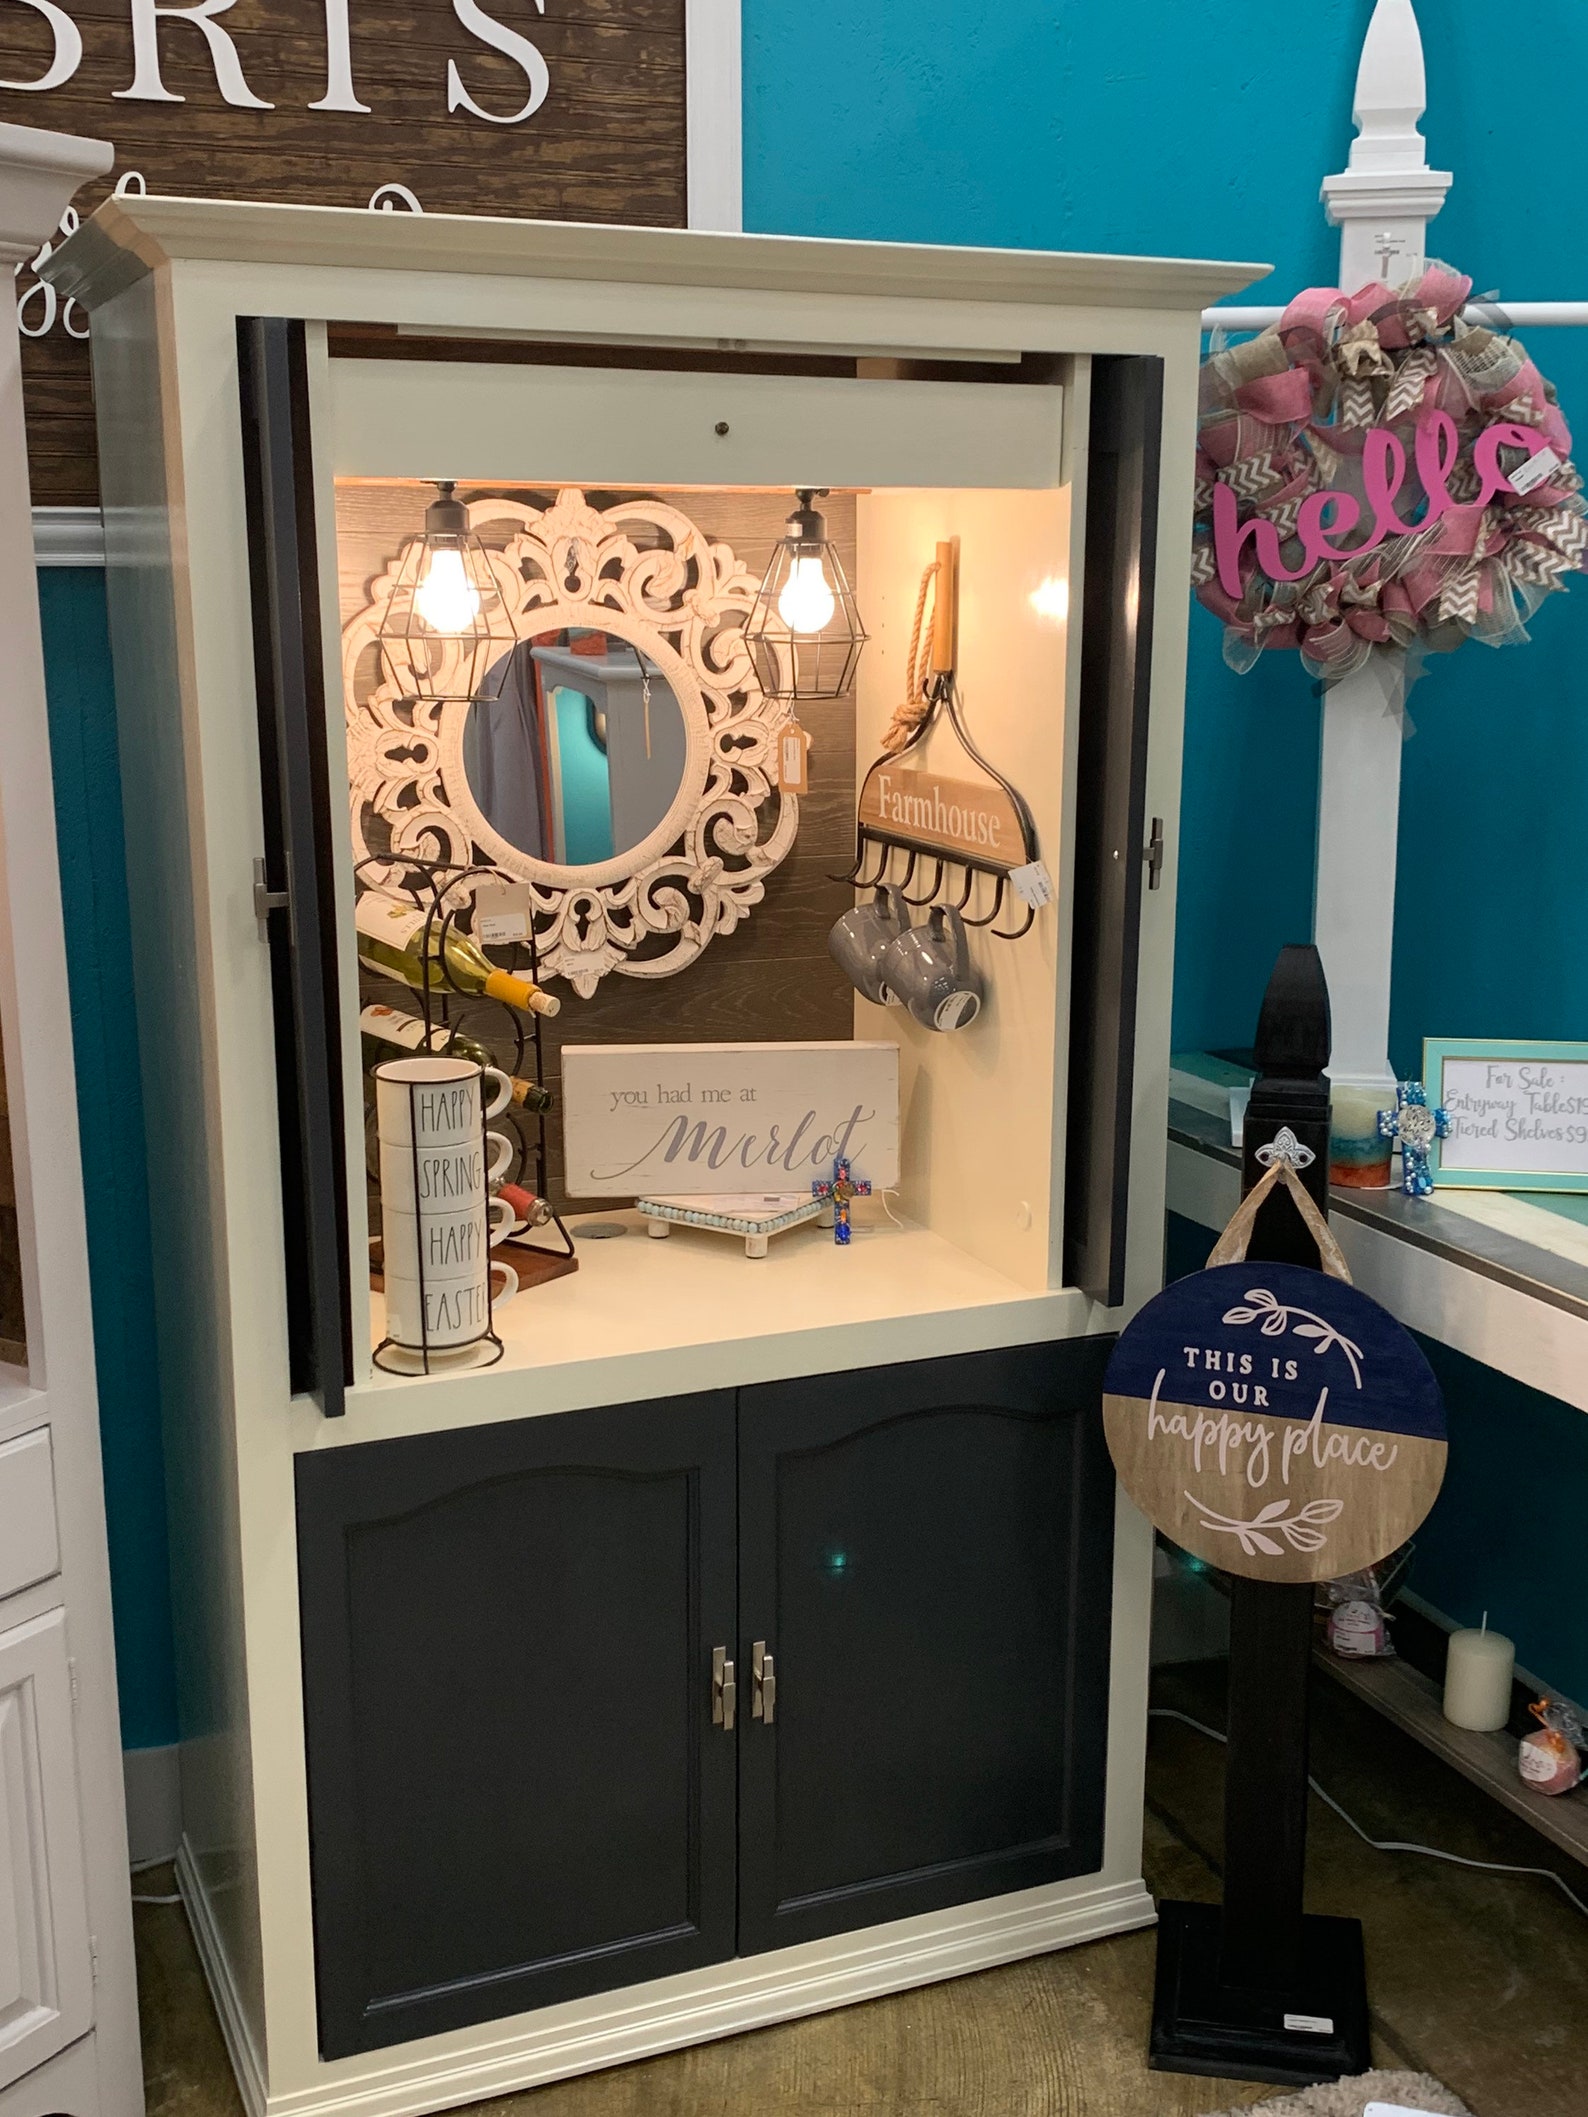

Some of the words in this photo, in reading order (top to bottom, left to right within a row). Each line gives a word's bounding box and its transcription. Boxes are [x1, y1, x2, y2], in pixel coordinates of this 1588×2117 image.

[1213, 409, 1552, 600] hello
[878, 774, 1001, 848] Farmhouse
[610, 1090, 648, 1111] you
[657, 1083, 692, 1104] had
[701, 1090, 731, 1103] me
[740, 1087, 757, 1102] at
[1486, 1065, 1512, 1089] For
[421, 1086, 474, 1132] HAPPY
[1444, 1088, 1516, 1118] Entryway
[590, 1104, 876, 1180] Merlot
[1450, 1115, 1498, 1139] Tiered
[1504, 1117, 1563, 1141] Shelves
[420, 1151, 481, 1199] SPRING
[430, 1217, 483, 1265] HAPPY
[424, 1282, 486, 1332] EASTE
[1184, 1346, 1253, 1375] THIS
[1271, 1358, 1298, 1380] IS
[1208, 1380, 1269, 1407] OUR
[1148, 1367, 1275, 1488] happy
[1282, 1386, 1398, 1485] place
